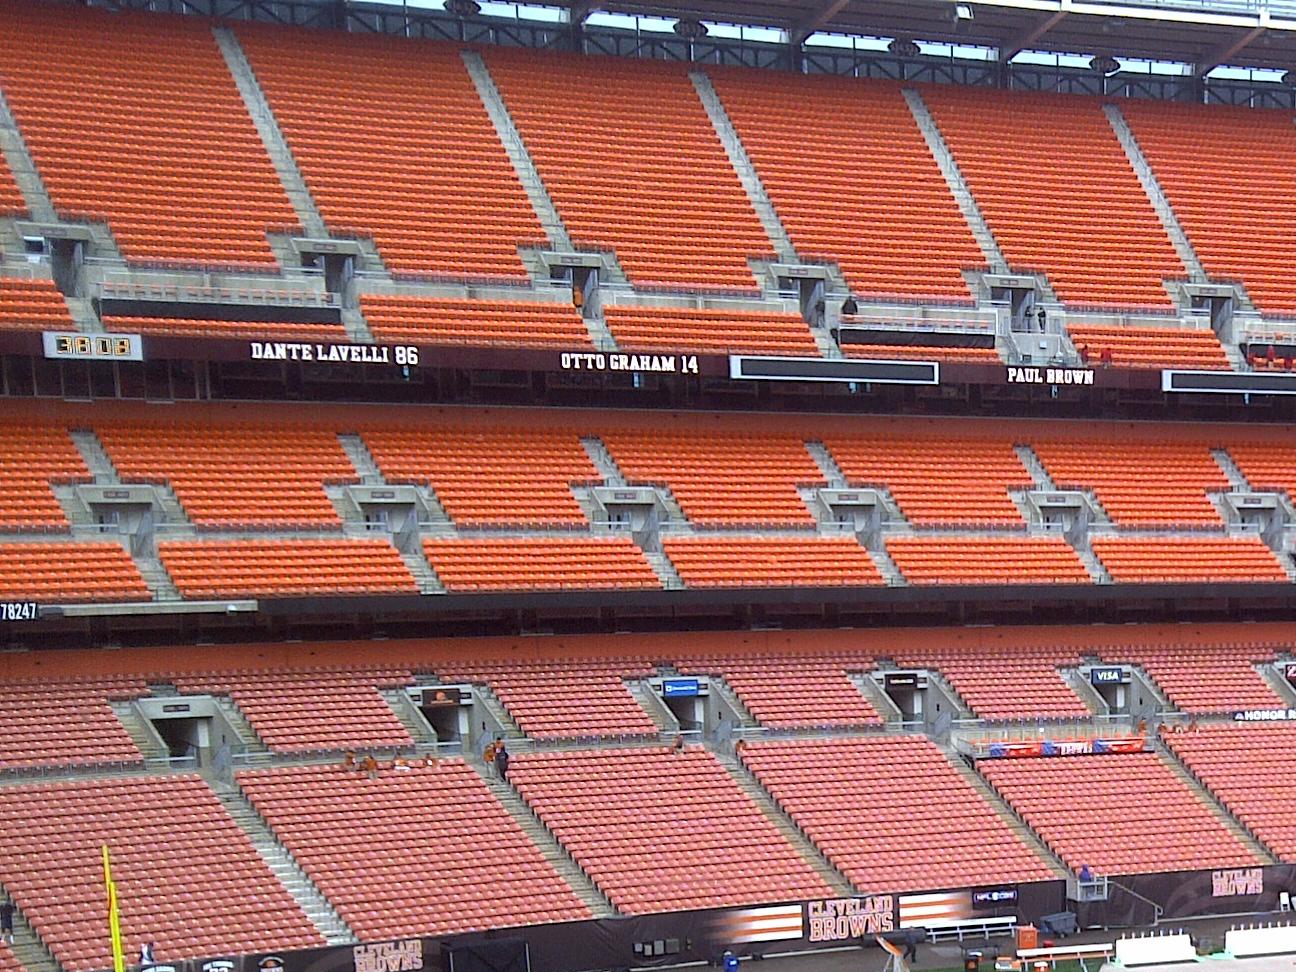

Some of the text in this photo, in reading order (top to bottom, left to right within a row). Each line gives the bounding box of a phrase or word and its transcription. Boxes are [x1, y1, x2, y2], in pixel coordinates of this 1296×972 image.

[251, 343, 418, 365] DANTE LAVELLI 86
[561, 353, 698, 374] OTTO GRAHAM 14
[1007, 367, 1094, 386] PAUL BROWN
[1096, 672, 1119, 681] VISA
[1244, 710, 1286, 721] HONOR
[808, 895, 893, 917] CLEVELAND
[808, 911, 894, 942] BROWNS
